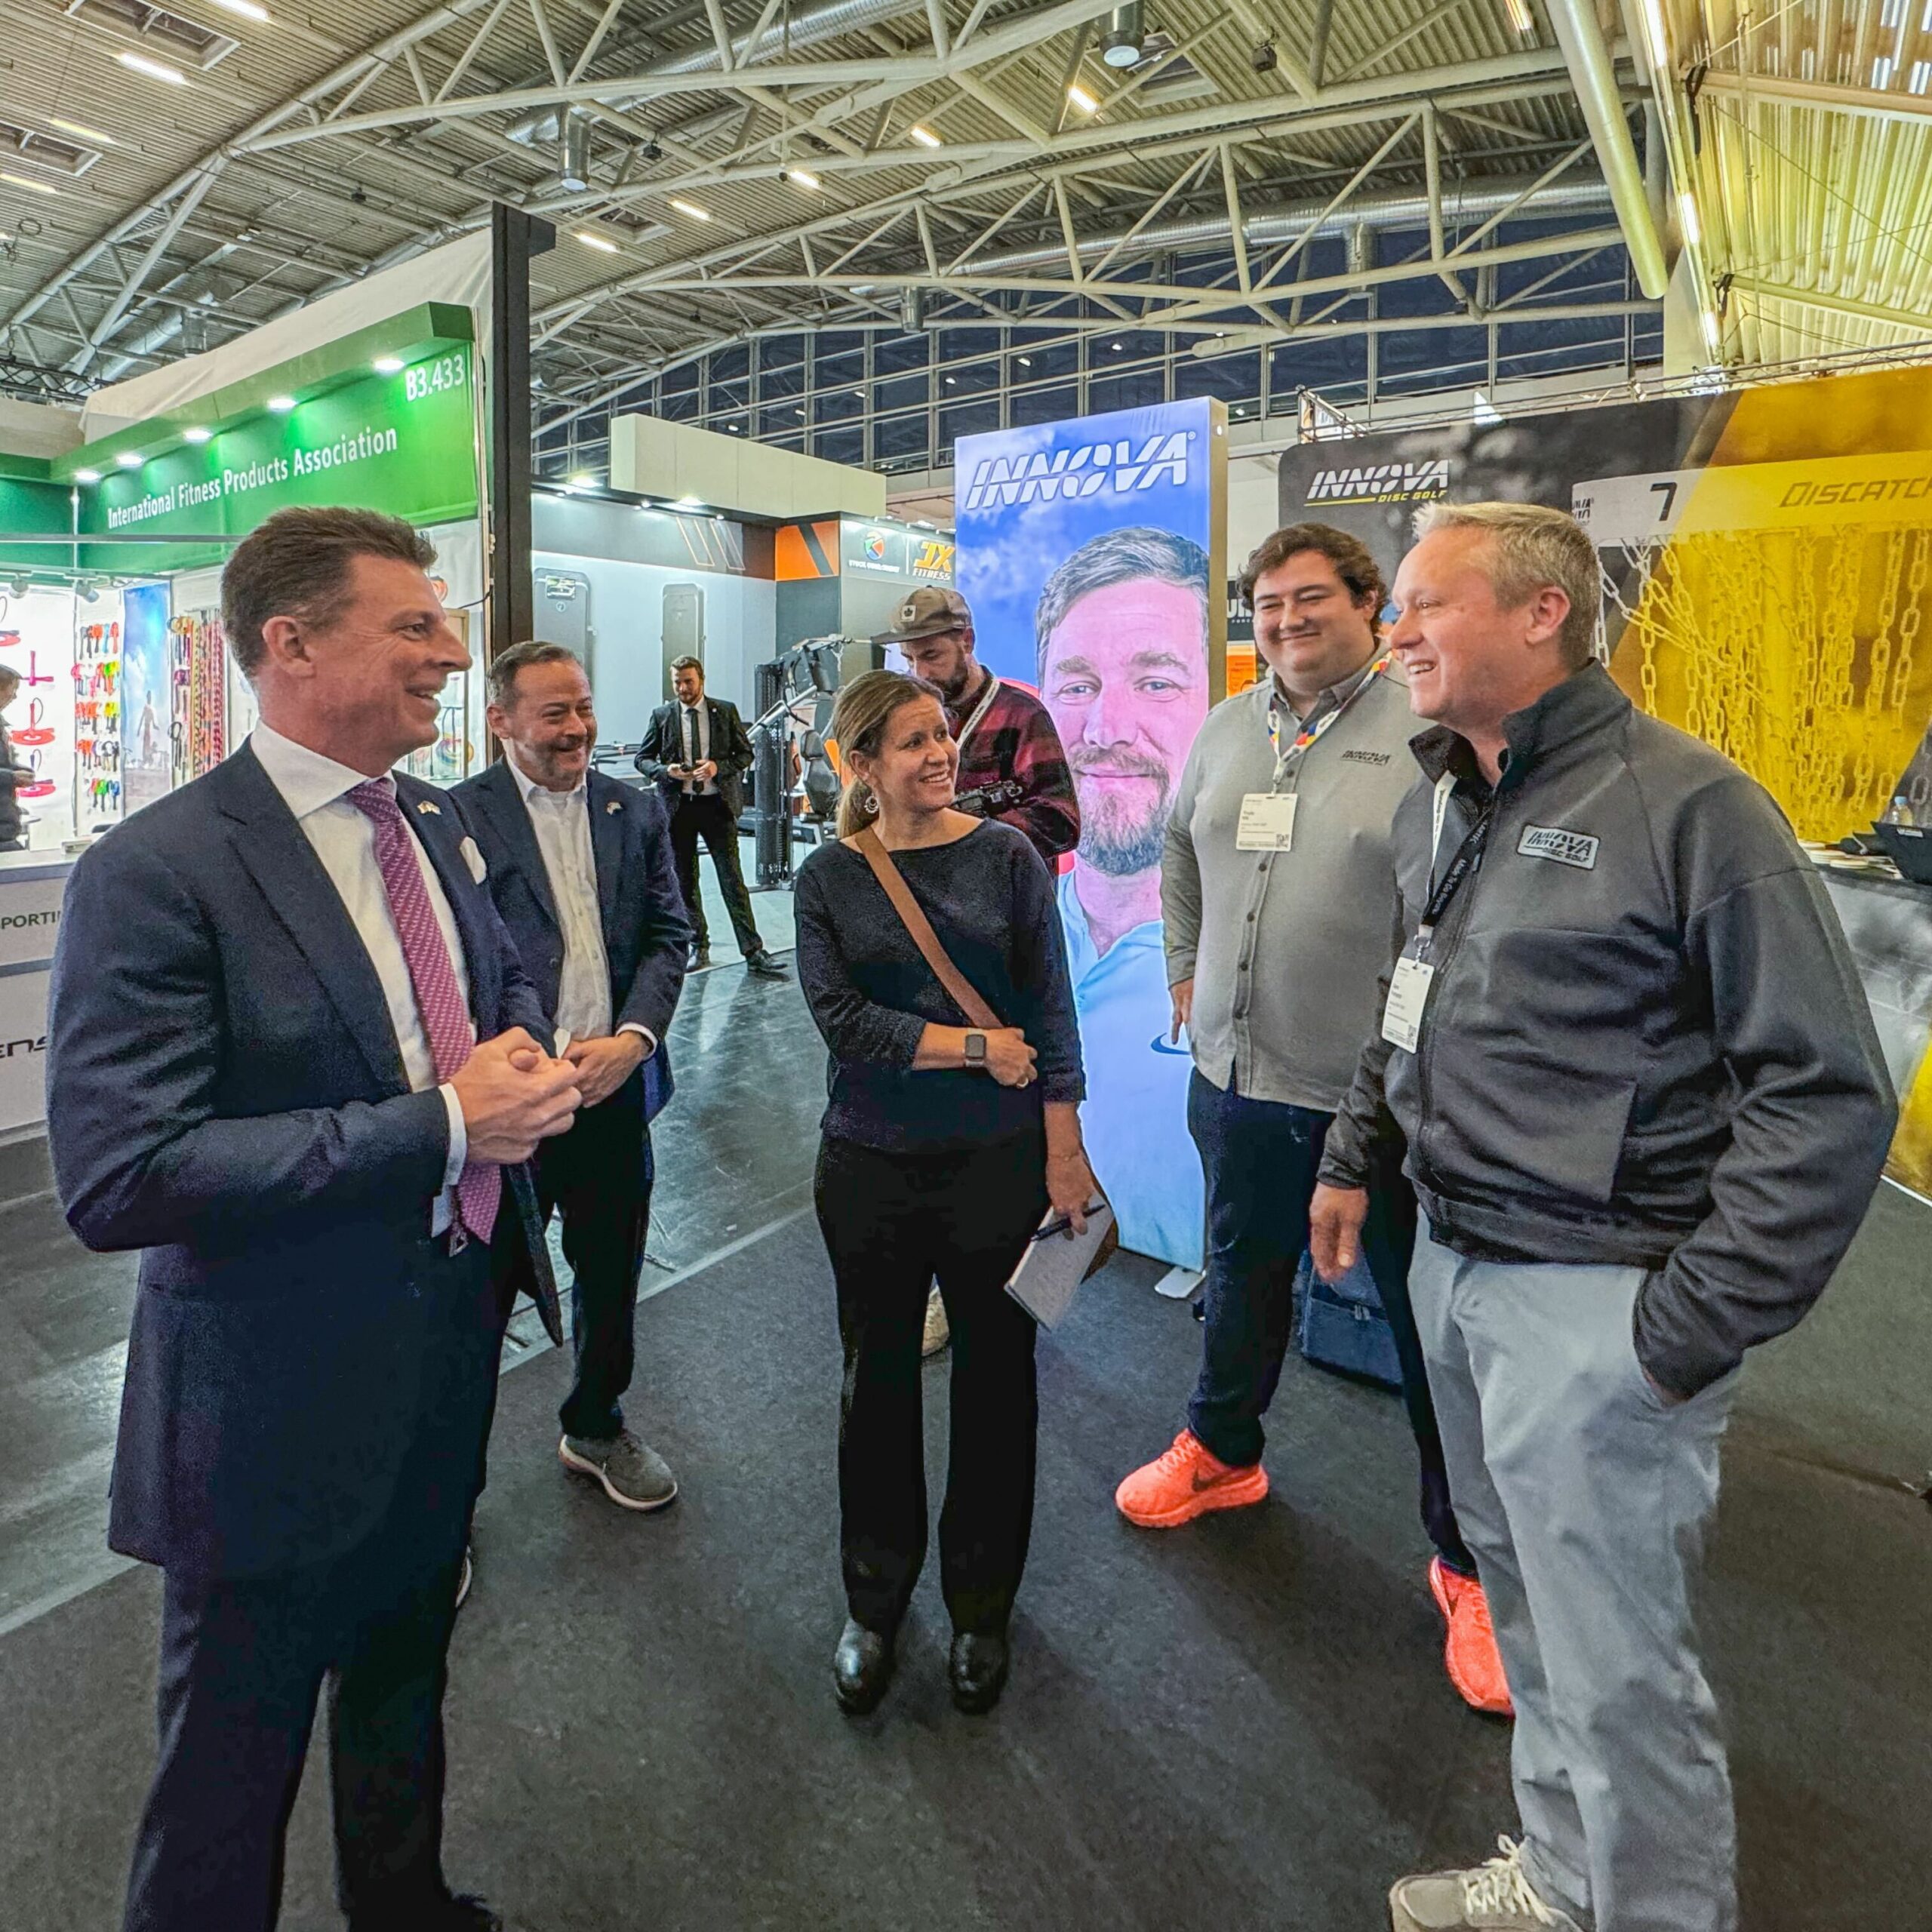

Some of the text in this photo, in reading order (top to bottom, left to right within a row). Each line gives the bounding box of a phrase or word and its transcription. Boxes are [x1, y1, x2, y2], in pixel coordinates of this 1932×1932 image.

[405, 354, 465, 401] B3.433
[107, 426, 398, 529] International Fitness Products Association
[1306, 460, 1449, 499] INNOVA
[1377, 489, 1447, 503] DISC GOLF
[1650, 481, 1678, 521] 7
[912, 567, 952, 580] FITNESS
[914, 540, 955, 572] JX
